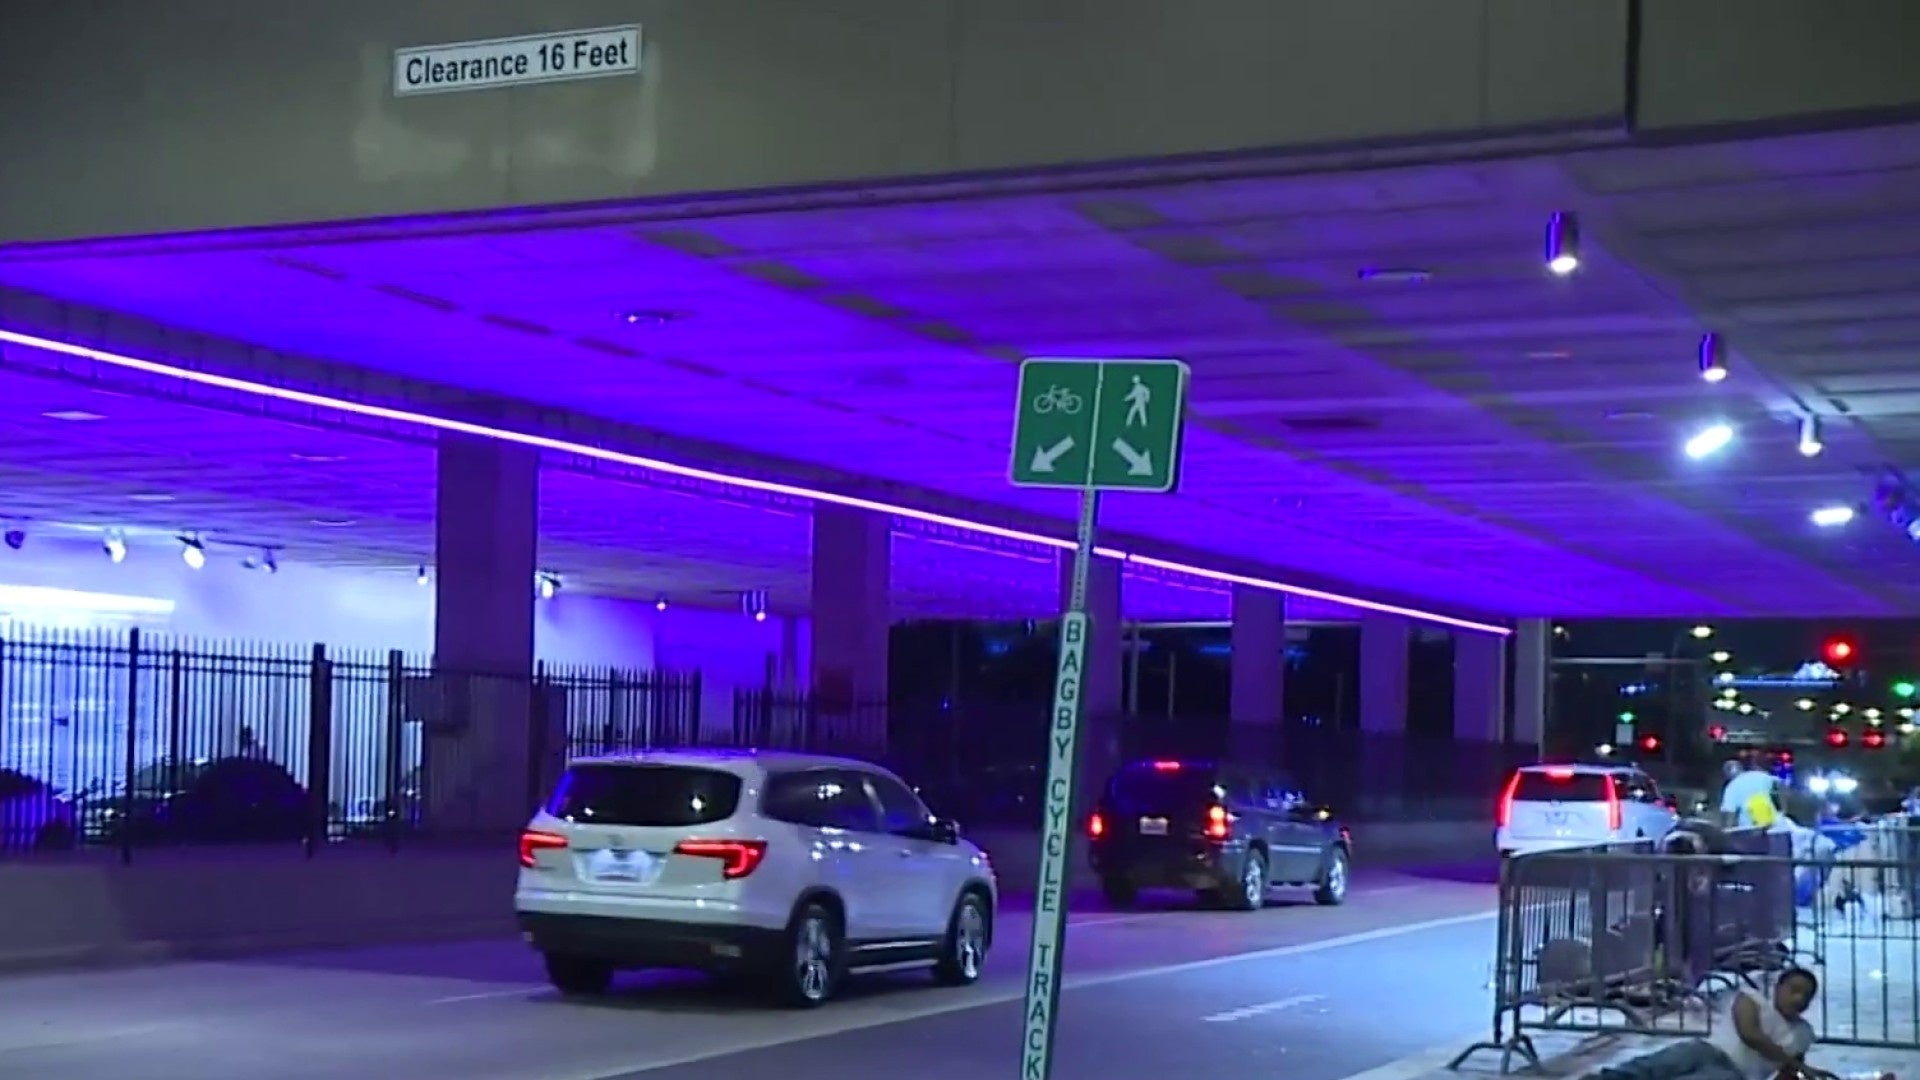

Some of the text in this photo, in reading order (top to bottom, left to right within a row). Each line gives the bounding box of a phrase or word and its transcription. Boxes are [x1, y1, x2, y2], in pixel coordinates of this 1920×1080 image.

[406, 37, 628, 85] Clearance 16 Feet
[1026, 619, 1082, 1079] BAGBY CYCLE TRACK
